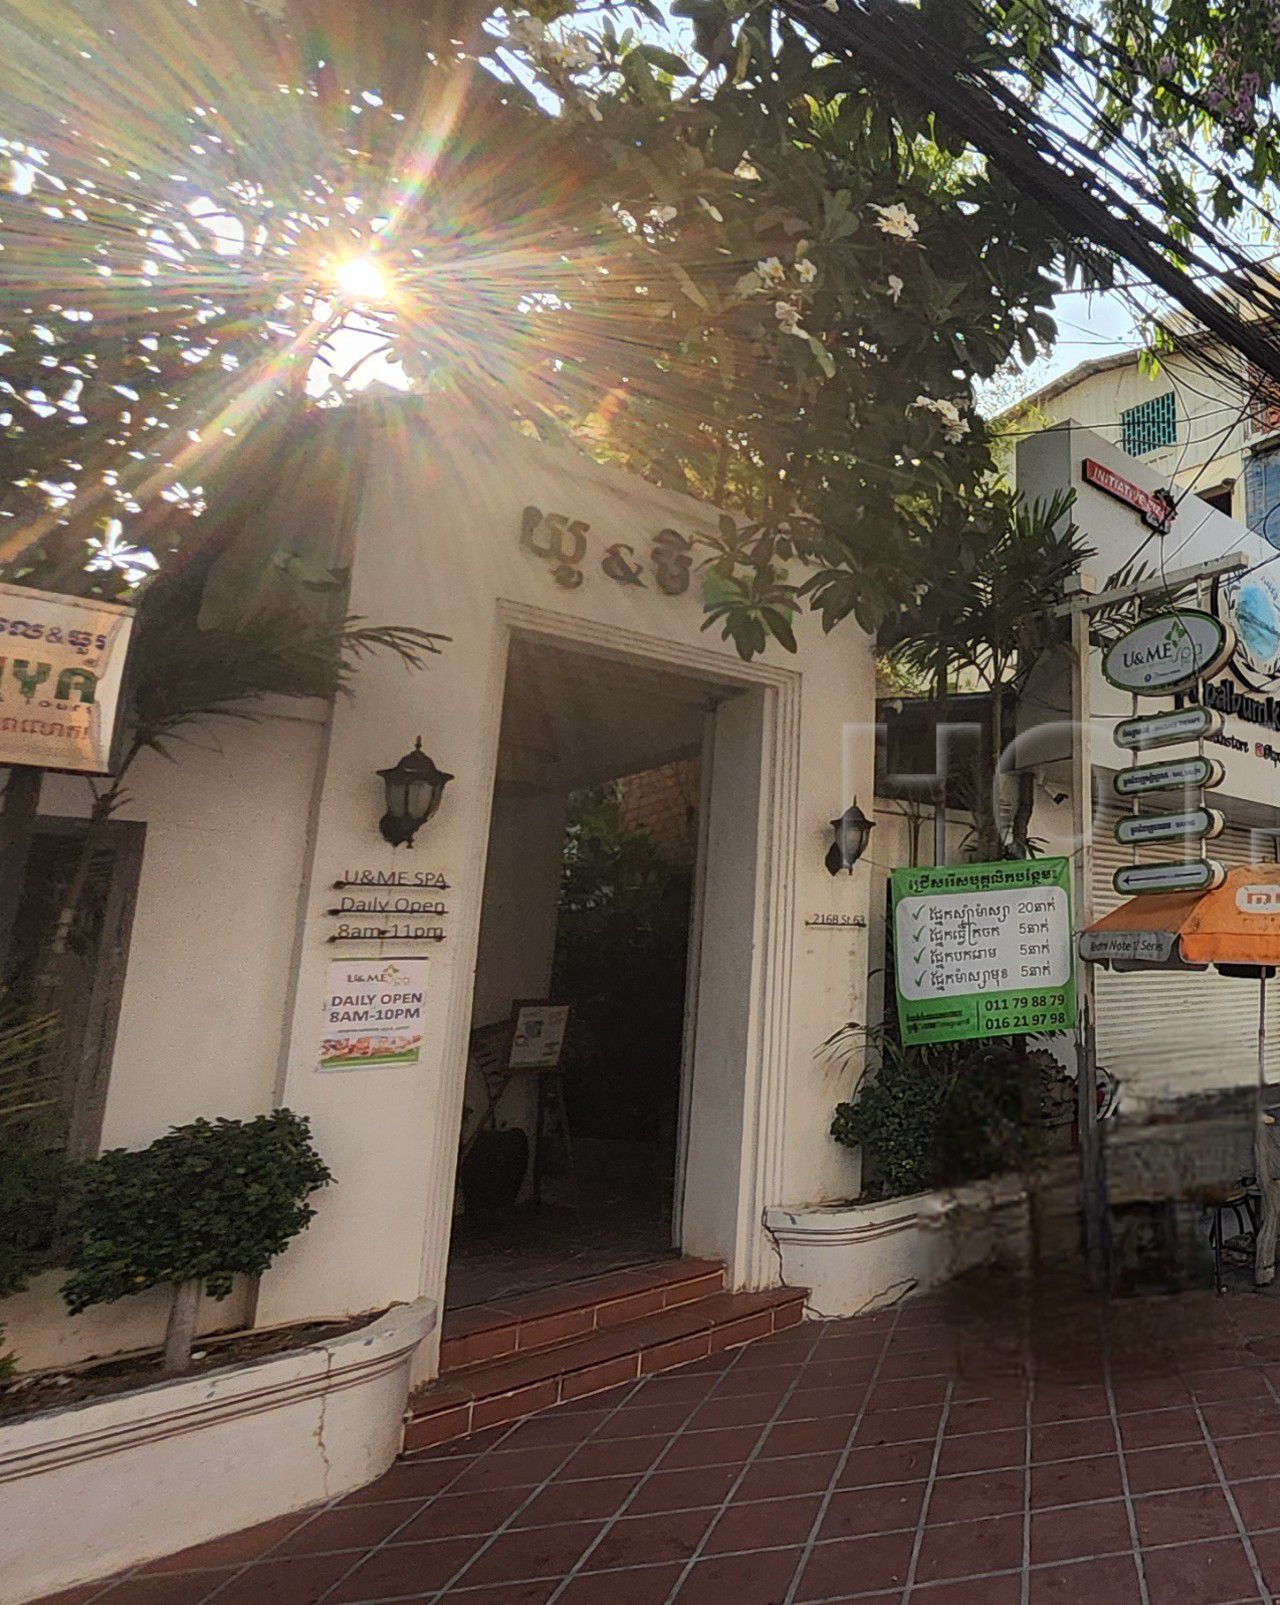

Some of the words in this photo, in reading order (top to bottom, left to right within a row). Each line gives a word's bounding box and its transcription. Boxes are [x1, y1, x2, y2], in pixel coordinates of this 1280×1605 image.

[1123, 643, 1172, 668] U&ME
[0, 656, 98, 704] YA
[414, 871, 447, 887] SPA
[395, 897, 446, 914] Open
[1110, 939, 1131, 952] Note
[331, 994, 377, 1007] DAILY
[380, 993, 423, 1005] OPEN
[985, 999, 1009, 1011] 011
[1012, 997, 1028, 1009] 79
[1032, 996, 1047, 1007] 88
[1050, 994, 1065, 1006] 79
[329, 1008, 421, 1023] 8AM-10PM
[985, 1017, 1010, 1030] 016
[1013, 1015, 1029, 1028] 21
[1032, 1013, 1047, 1026] 97
[1050, 1012, 1066, 1024] 98
